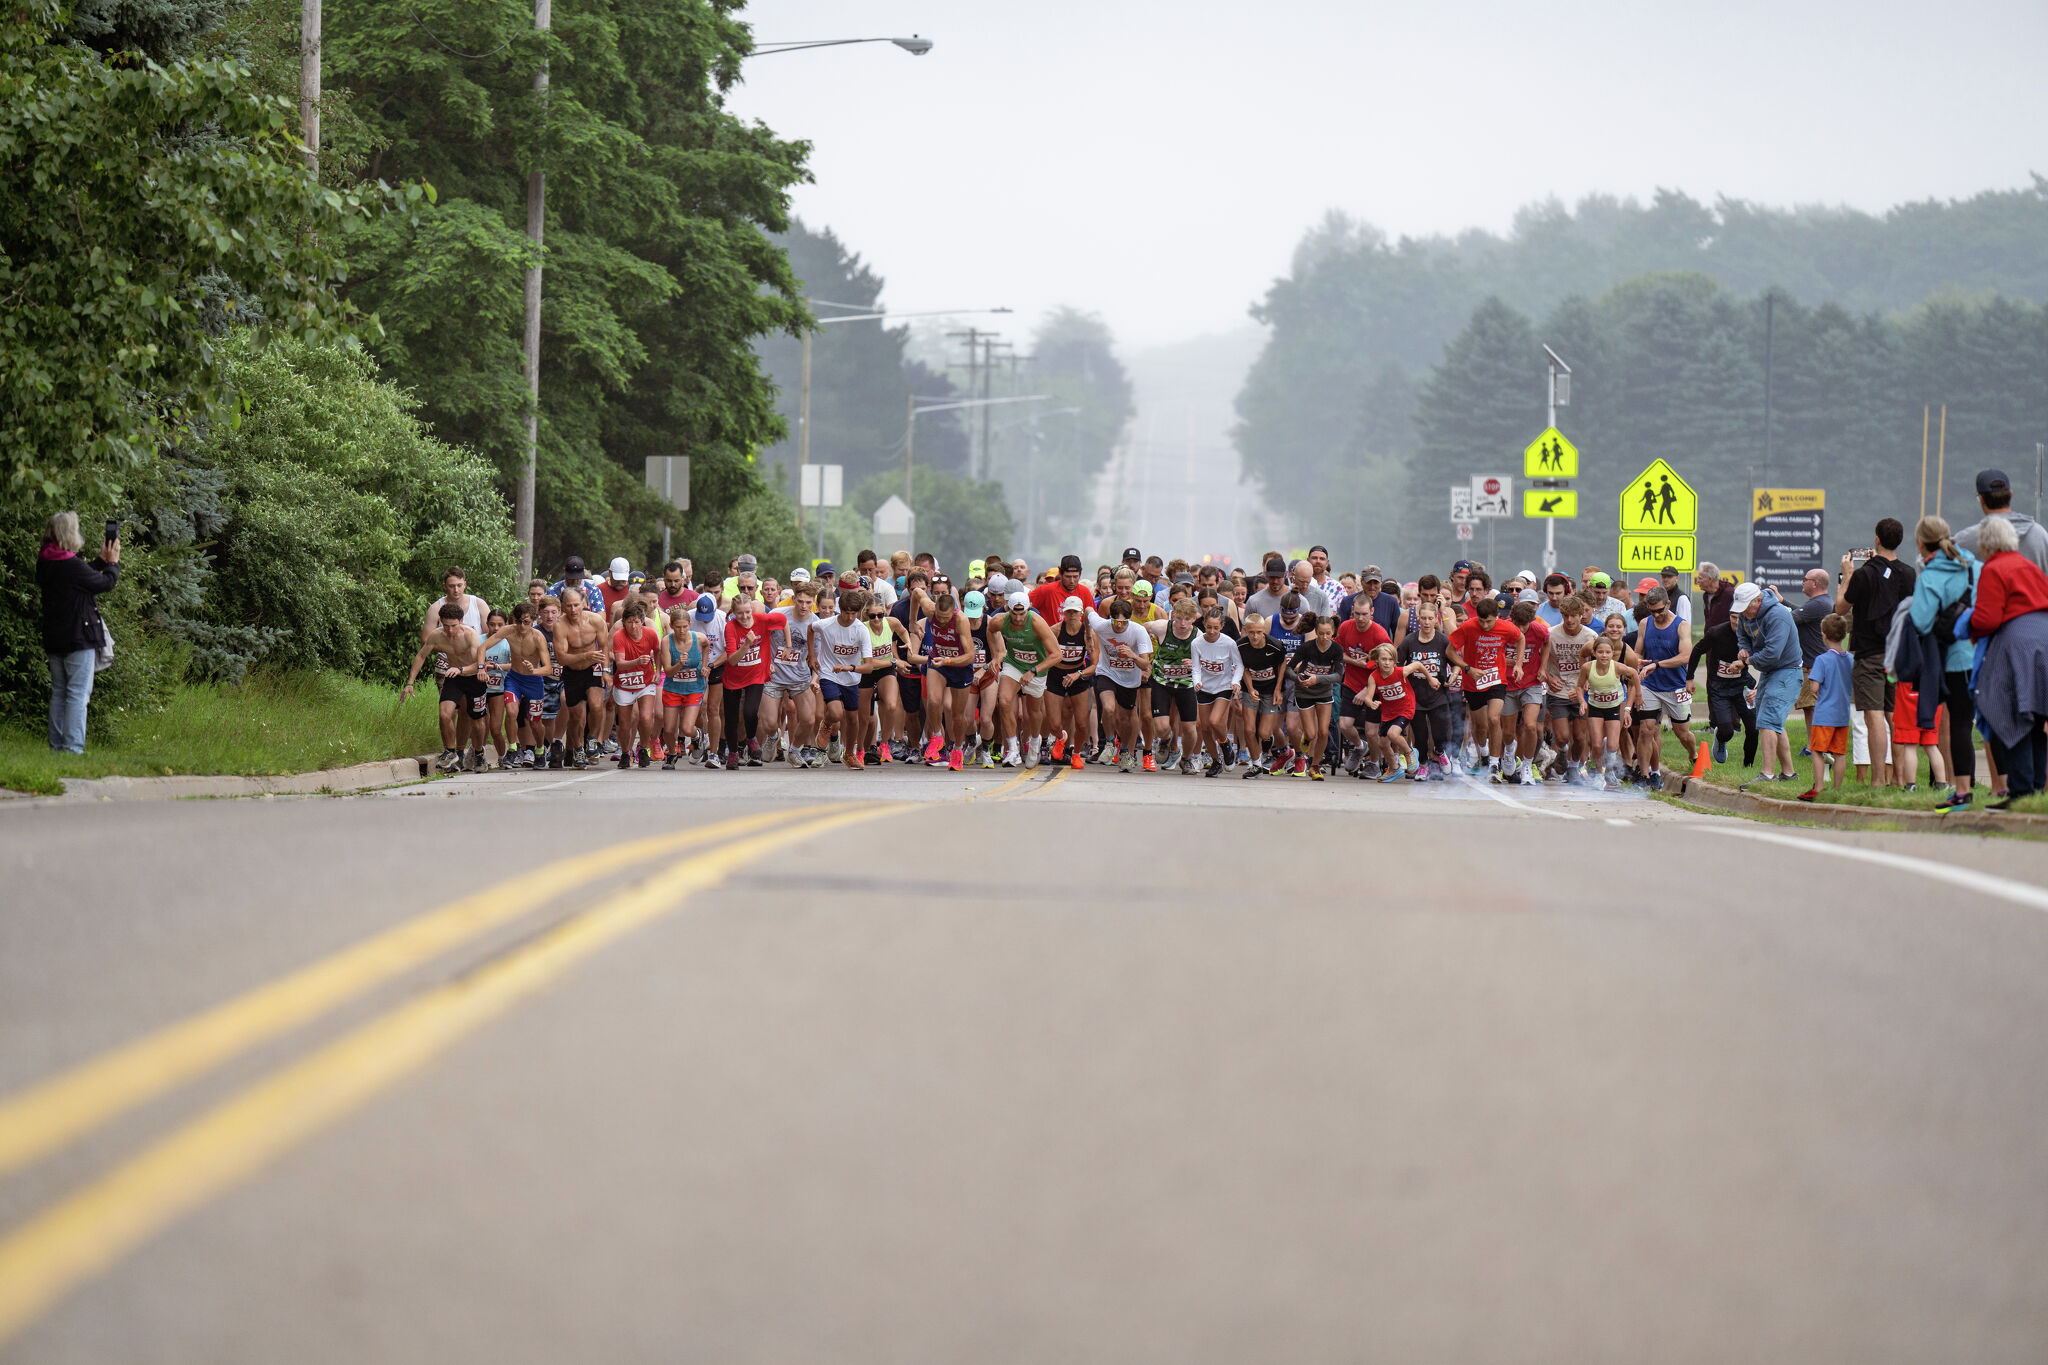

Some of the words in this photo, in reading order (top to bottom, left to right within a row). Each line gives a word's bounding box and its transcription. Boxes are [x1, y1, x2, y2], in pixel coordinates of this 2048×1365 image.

[1632, 546, 1684, 561] AHEAD
[835, 646, 859, 656] 2098
[871, 645, 892, 655] 2102
[1061, 650, 1083, 658] 2147
[776, 650, 799, 661] 244
[1111, 660, 1135, 669] 2223
[1202, 661, 1224, 672] 2221
[620, 676, 645, 686] 2141
[1380, 686, 1404, 697] 2019
[1594, 692, 1619, 702] 2107
